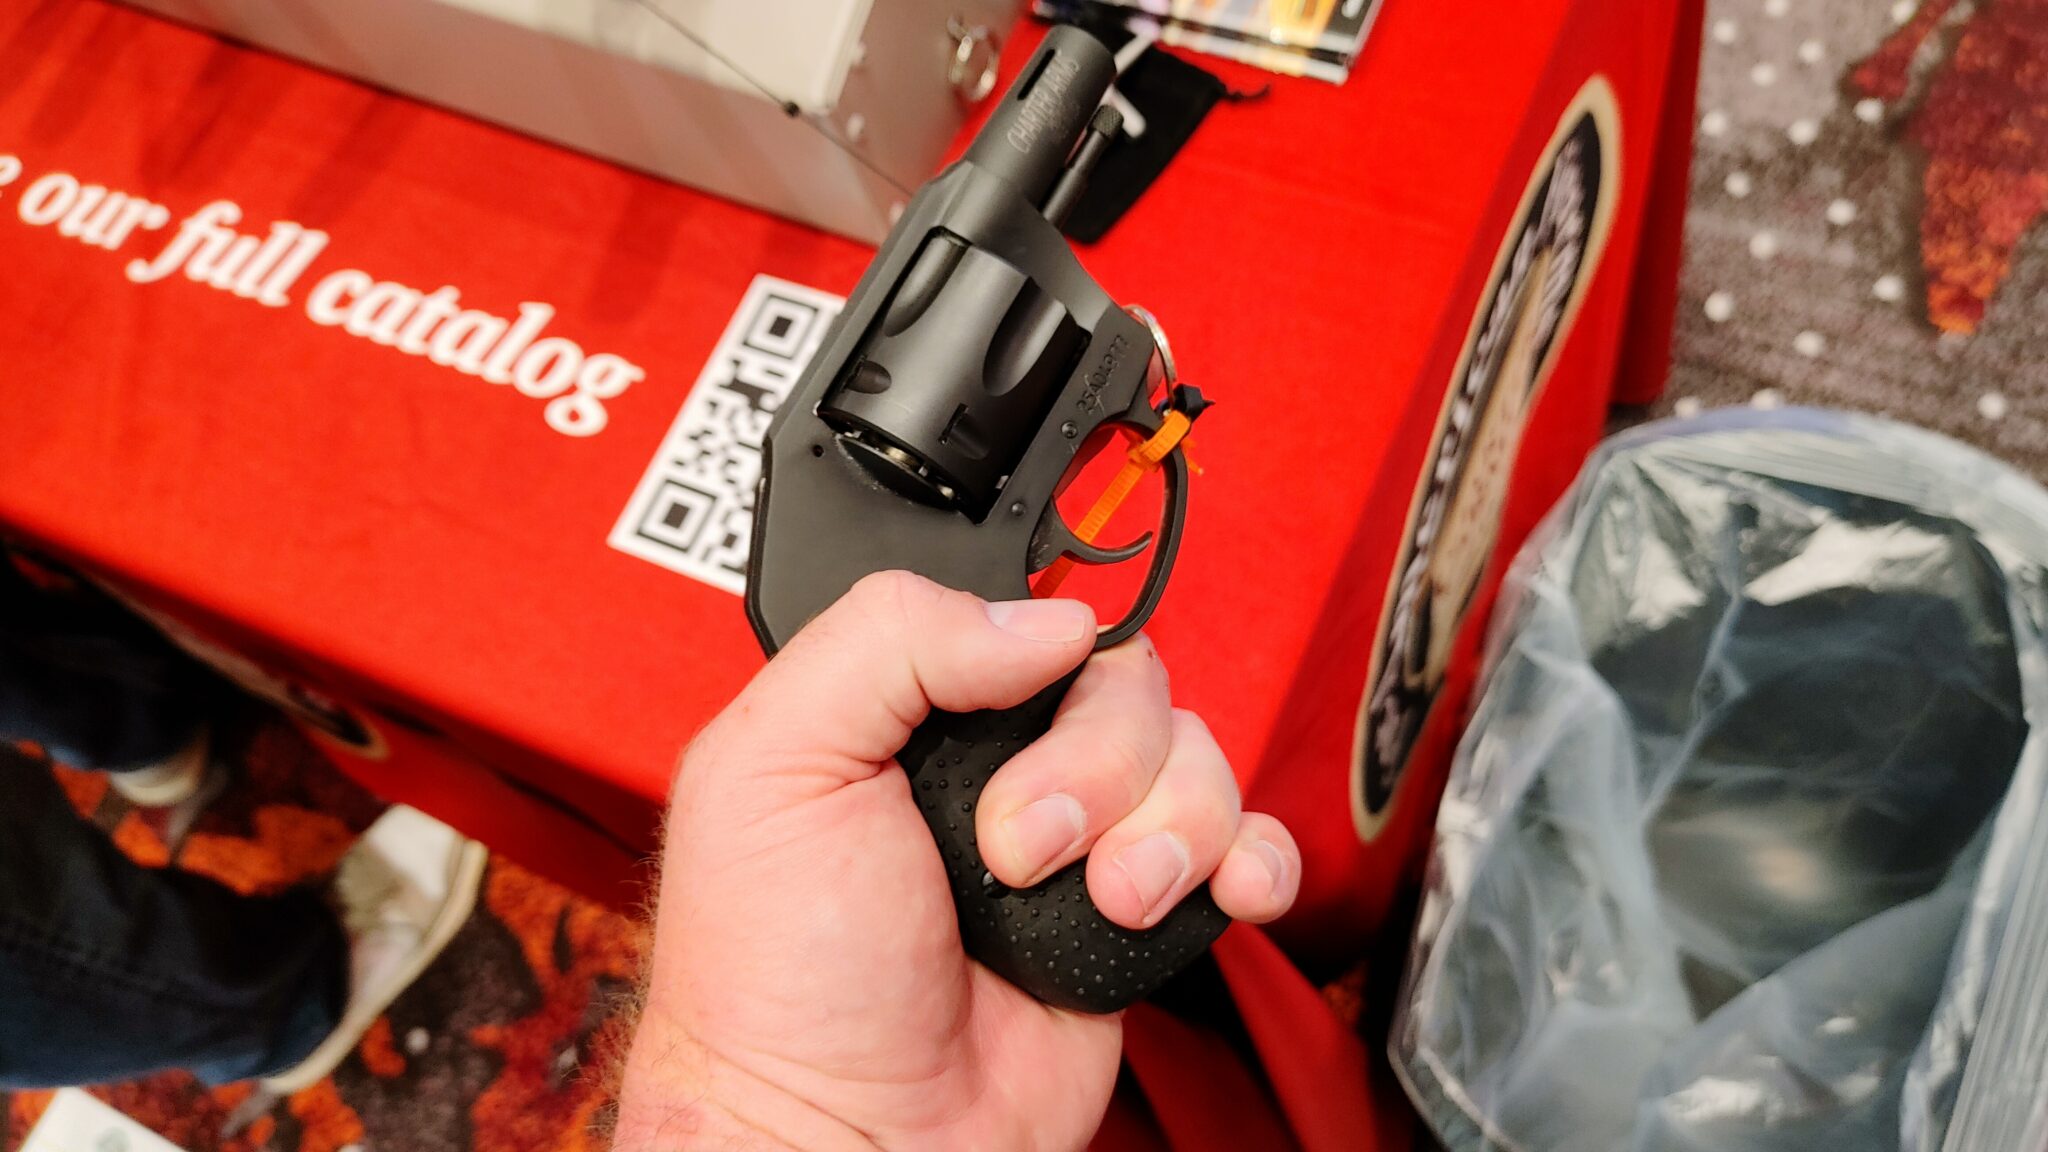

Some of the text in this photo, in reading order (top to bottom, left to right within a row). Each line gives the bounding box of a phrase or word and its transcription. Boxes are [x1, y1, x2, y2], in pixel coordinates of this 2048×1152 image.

[17, 172, 172, 252] our
[126, 199, 329, 308] full
[305, 268, 646, 437] catalog
